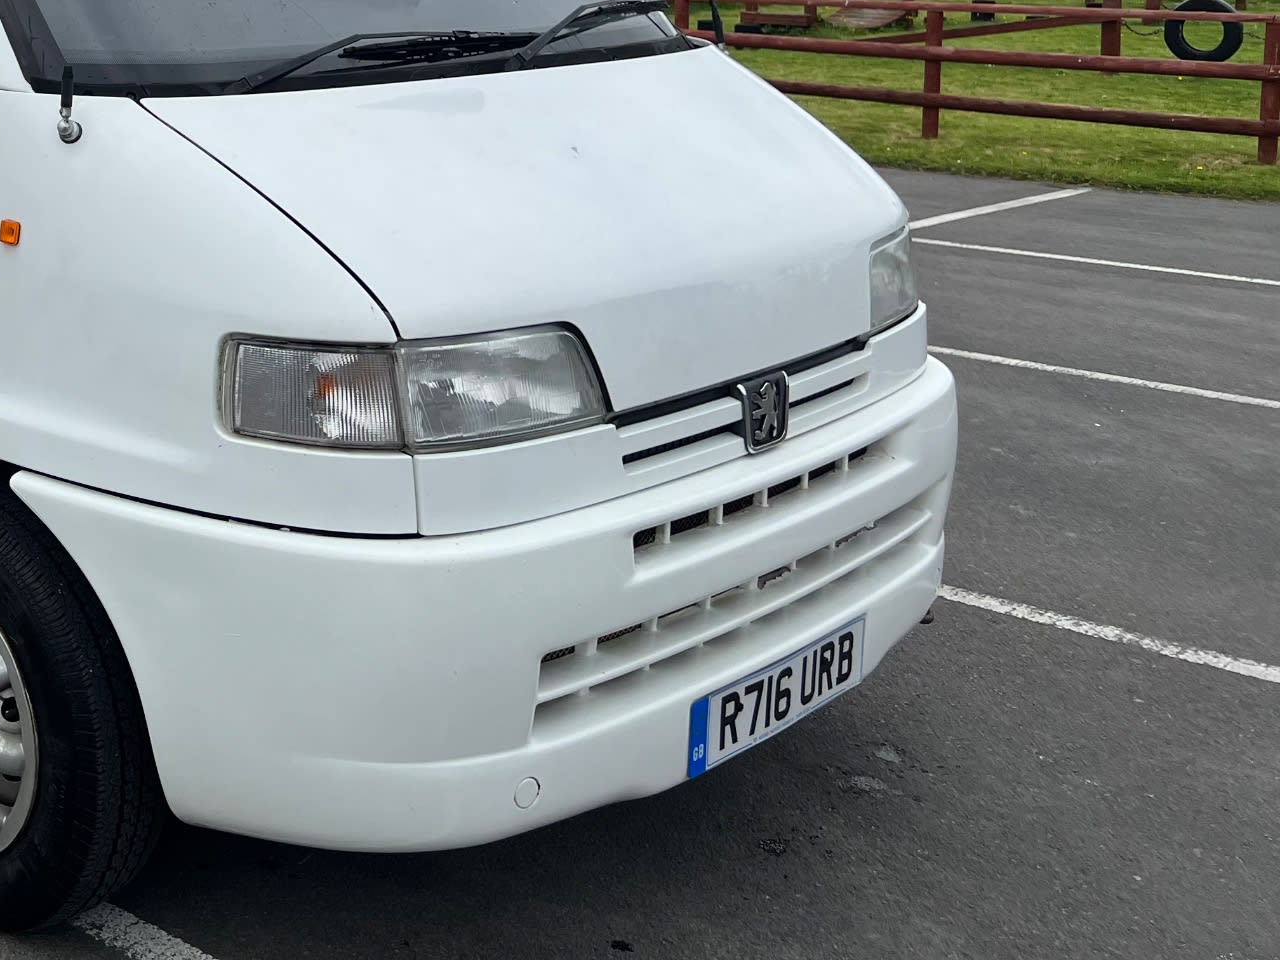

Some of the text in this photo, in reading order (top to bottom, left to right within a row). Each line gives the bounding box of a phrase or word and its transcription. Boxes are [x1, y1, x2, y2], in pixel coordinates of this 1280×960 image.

[720, 666, 793, 751] R716
[800, 631, 854, 706] URB
[693, 743, 705, 761] GB
